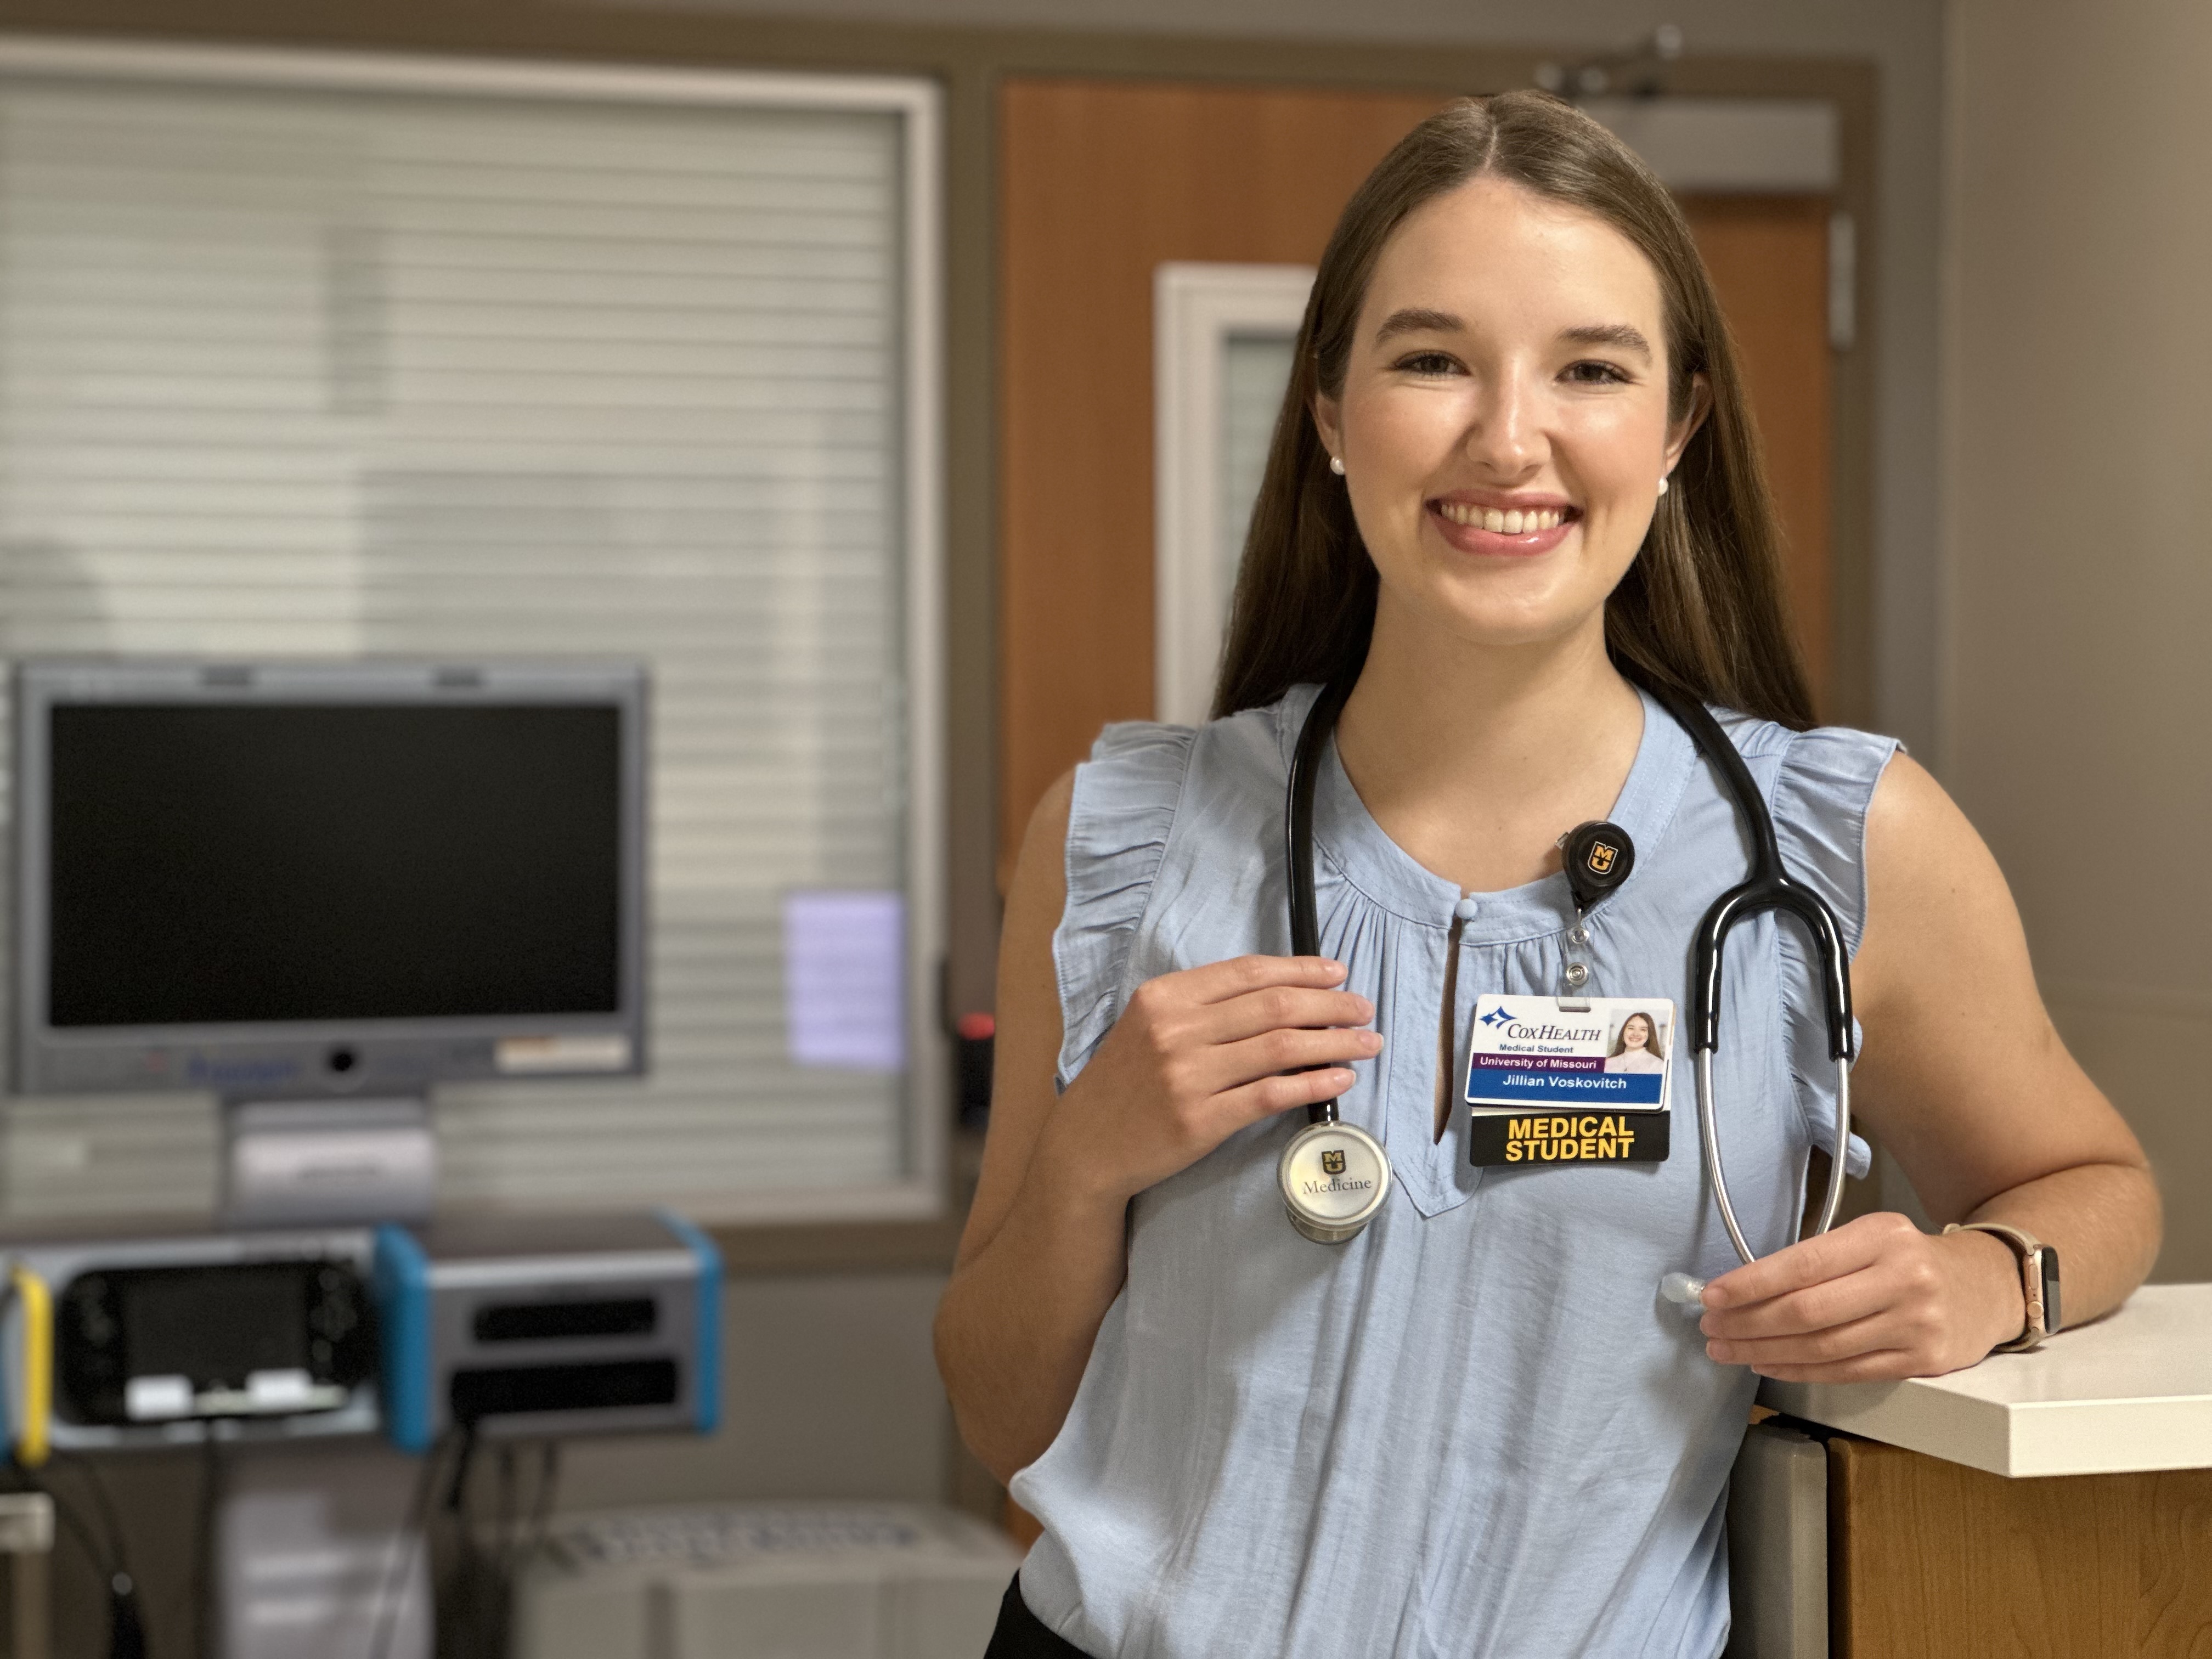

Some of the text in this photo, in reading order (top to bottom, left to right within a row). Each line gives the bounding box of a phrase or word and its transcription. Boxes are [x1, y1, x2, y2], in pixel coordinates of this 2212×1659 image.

[1499, 1044, 1573, 1053] Medical Student
[1480, 1057, 1597, 1069] University of Missouri
[1503, 1075, 1627, 1089] Jillian Voskovitch
[1508, 1116, 1634, 1139] MEDICAL
[1505, 1138, 1635, 1162] STUDENT
[1303, 1178, 1372, 1194] Medicine
